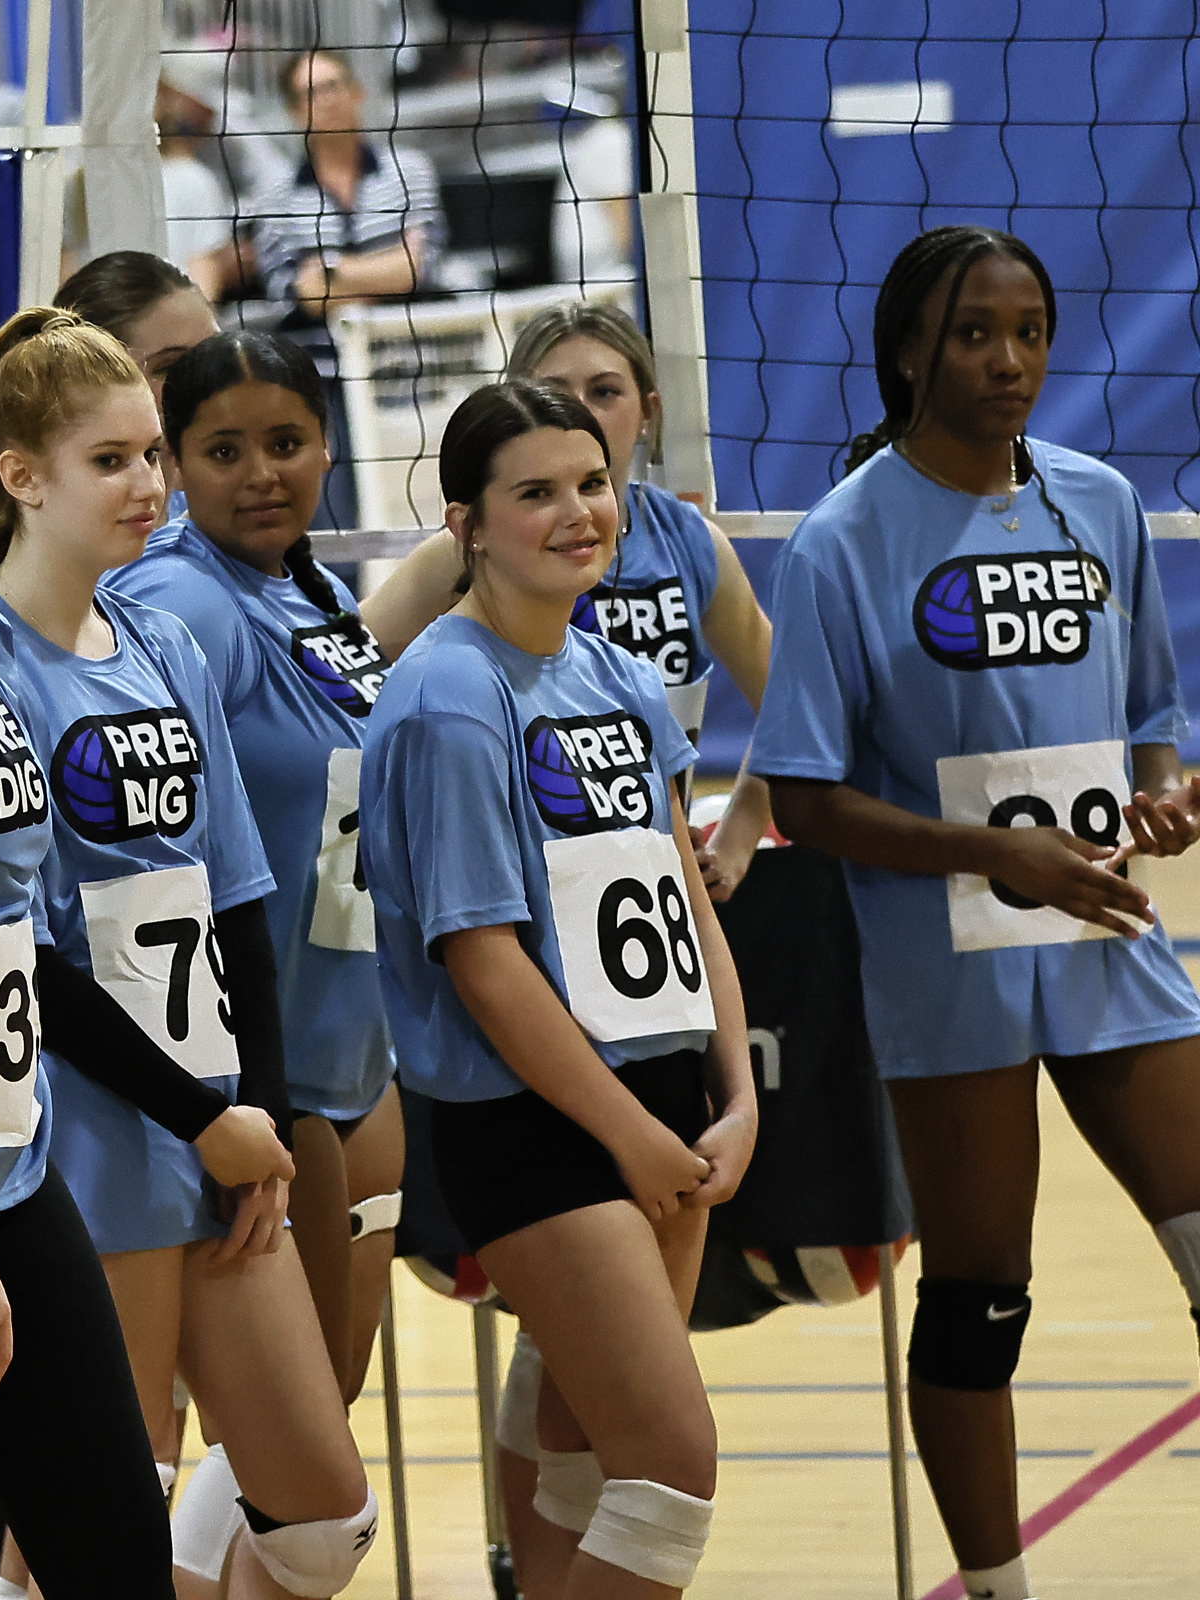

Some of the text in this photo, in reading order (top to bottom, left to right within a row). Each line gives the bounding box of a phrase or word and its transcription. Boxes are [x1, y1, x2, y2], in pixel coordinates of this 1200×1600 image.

[976, 559, 1103, 605] PREP
[594, 586, 689, 641] PRE
[985, 608, 1081, 658] DIG
[122, 775, 188, 827] DIG
[598, 873, 702, 1000] 68
